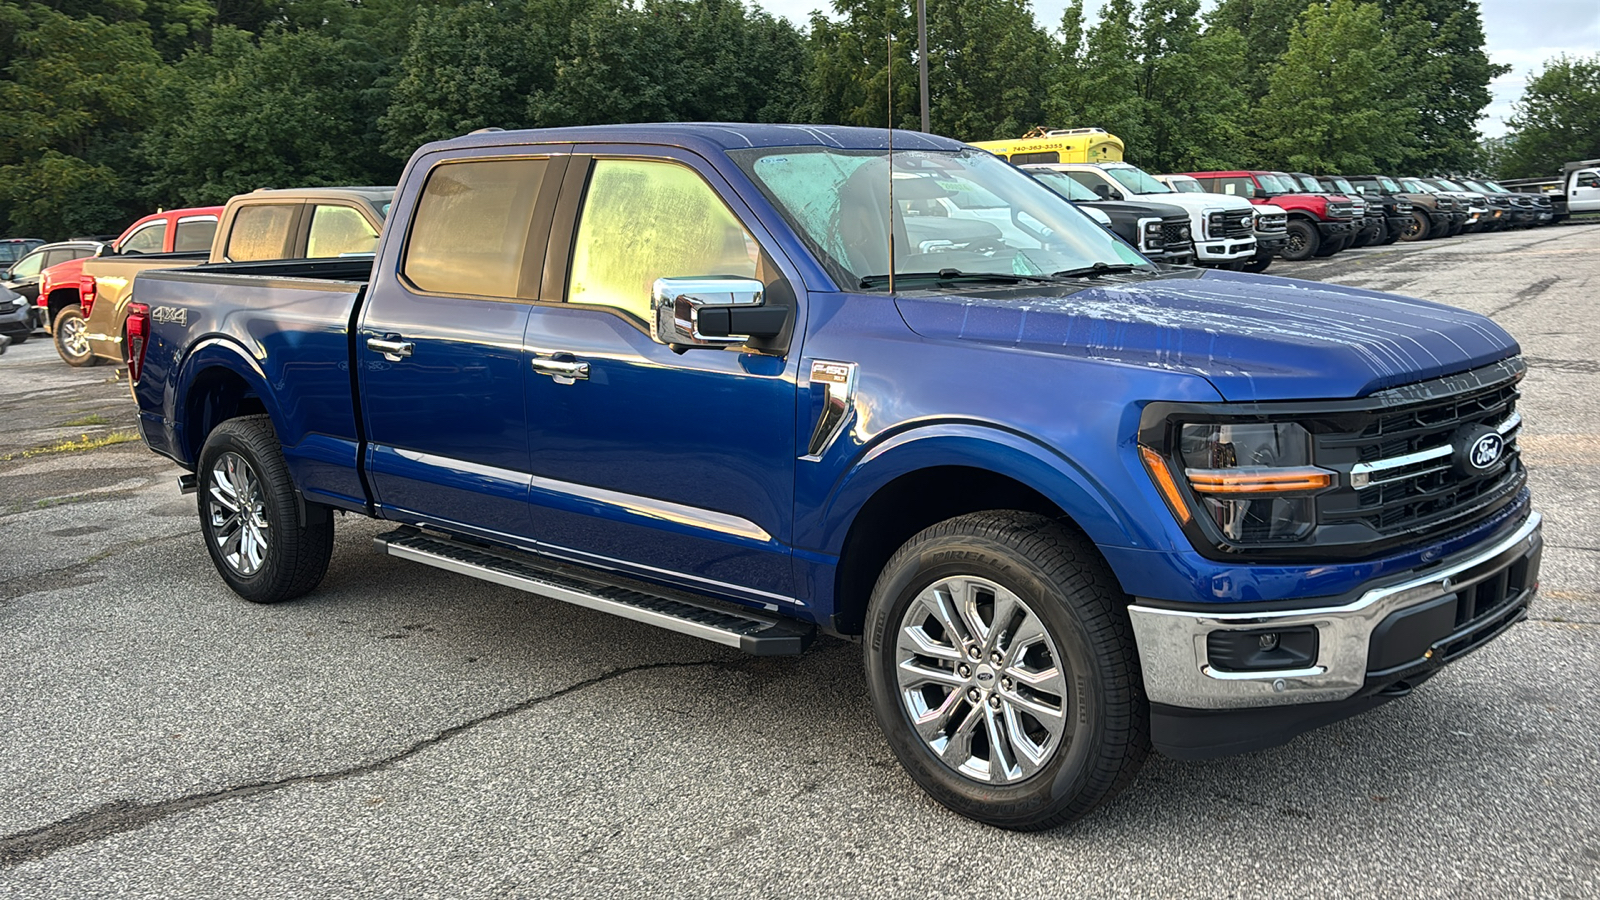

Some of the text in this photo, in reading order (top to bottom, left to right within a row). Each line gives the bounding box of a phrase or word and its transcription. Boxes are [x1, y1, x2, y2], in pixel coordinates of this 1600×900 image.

[1013, 143, 1063, 152] 740-363-3355
[813, 364, 848, 376] F-150
[1475, 437, 1500, 465] Ford
[932, 550, 1012, 572] PIRELLI
[872, 609, 886, 652] PIRELLI
[1077, 674, 1087, 724] PIRELLI
